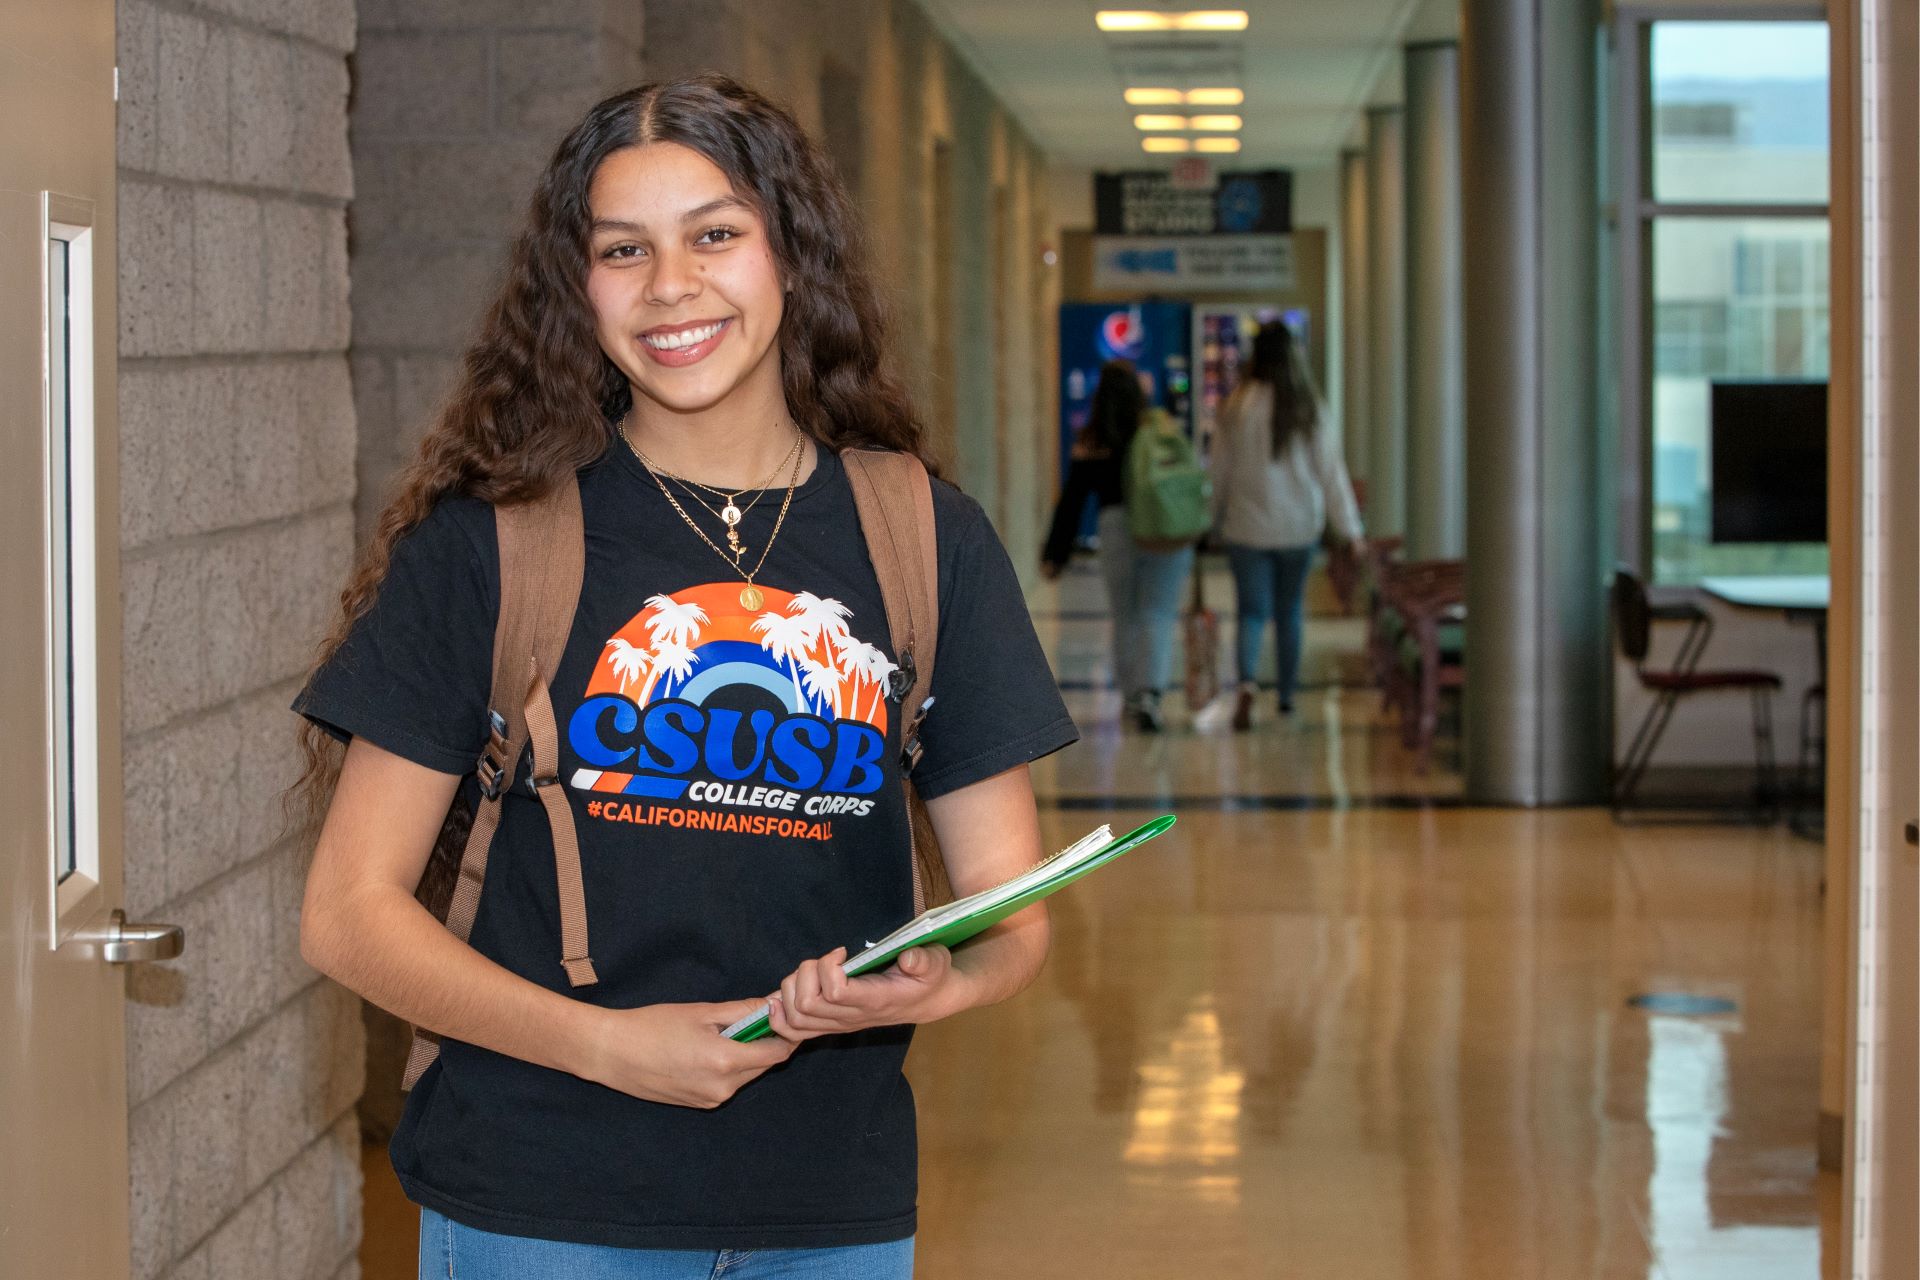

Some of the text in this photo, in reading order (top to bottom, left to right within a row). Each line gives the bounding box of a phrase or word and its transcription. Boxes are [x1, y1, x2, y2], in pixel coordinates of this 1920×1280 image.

[569, 697, 884, 793] CSUSB
[689, 781, 875, 816] COLLEGE CORPS
